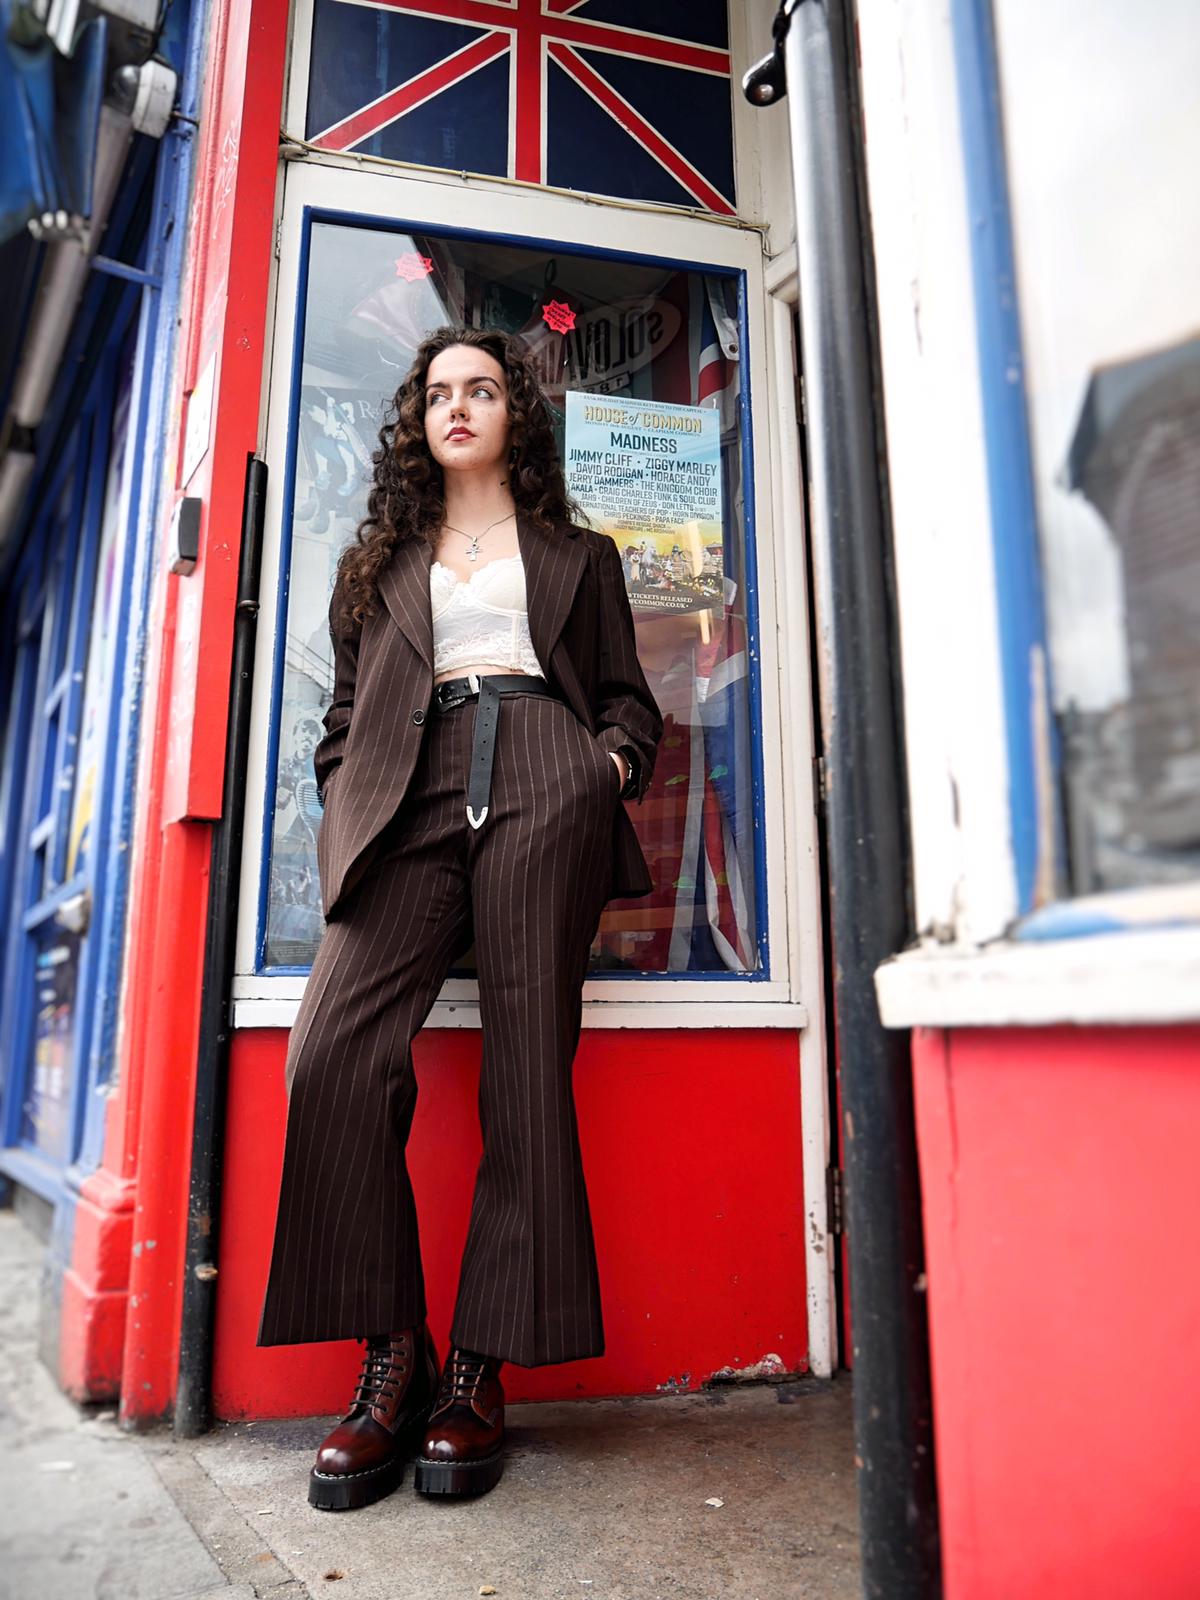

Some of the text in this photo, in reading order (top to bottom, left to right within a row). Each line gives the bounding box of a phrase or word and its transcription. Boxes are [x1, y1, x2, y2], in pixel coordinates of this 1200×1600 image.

[584, 405, 702, 433] HOUSE of COMMON
[611, 432, 678, 454] MADNESS
[569, 448, 603, 463] JIMMY
[604, 453, 633, 466] CLIFF
[645, 457, 675, 472] ZIGGY
[676, 460, 717, 476] MARLEY
[569, 472, 718, 497] JERRY DAMMERS THE KINGDOM CHOIR
[576, 462, 711, 487] DAVID RODIGAN HORACE ANDY
[571, 483, 717, 505] AKALA CRAIG CHARLES FUNK & SOUL CLUB
[602, 495, 633, 505] CHILDREN
[642, 500, 657, 508] ZEUS
[604, 510, 685, 525] CHRIS PECKINGS PAPA FACE
[618, 505, 647, 514] TEACHERS
[673, 510, 689, 518] HORN
[690, 512, 714, 520] DIVISION
[633, 592, 659, 600] TICKETS
[660, 595, 693, 603] RELEASED
